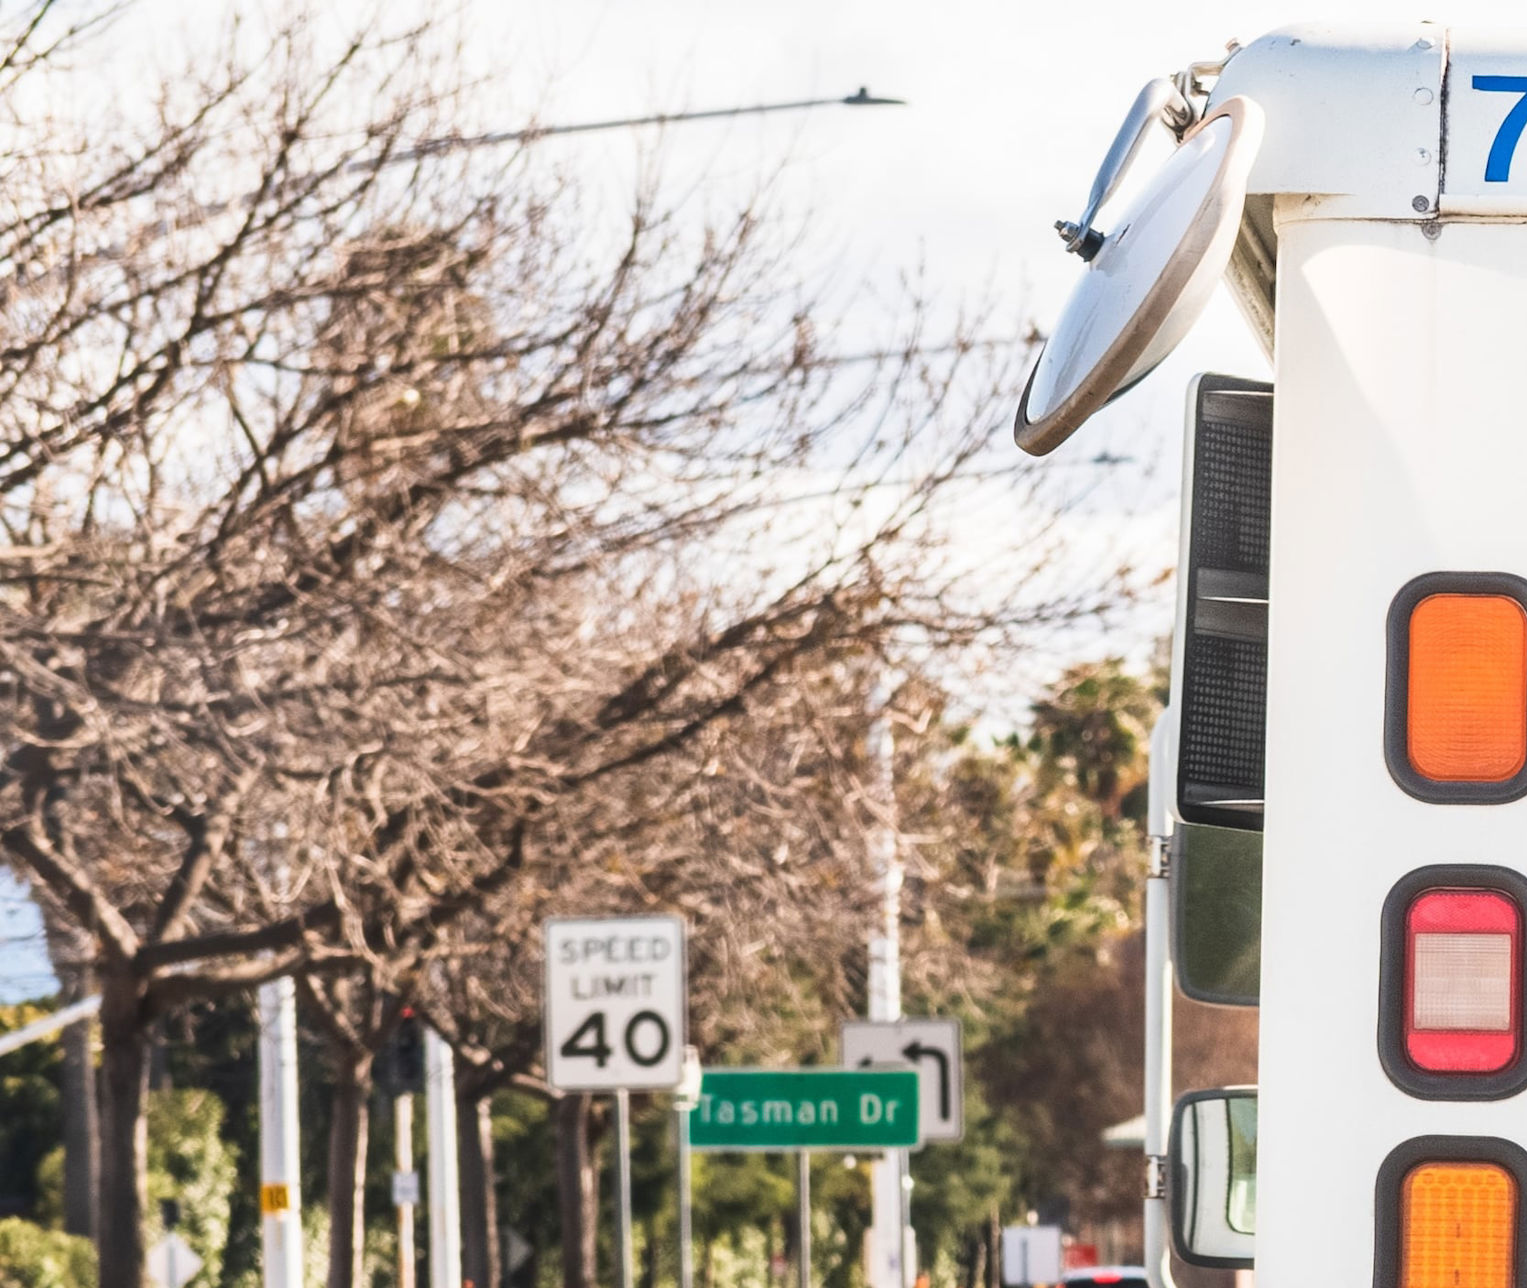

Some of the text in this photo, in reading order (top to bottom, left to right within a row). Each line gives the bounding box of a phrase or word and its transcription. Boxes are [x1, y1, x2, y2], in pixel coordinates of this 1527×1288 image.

[560, 935, 671, 964] SPEED
[571, 973, 655, 1001] LIMIT
[560, 1009, 671, 1069] 40
[699, 1092, 901, 1125] Tasman Dr
